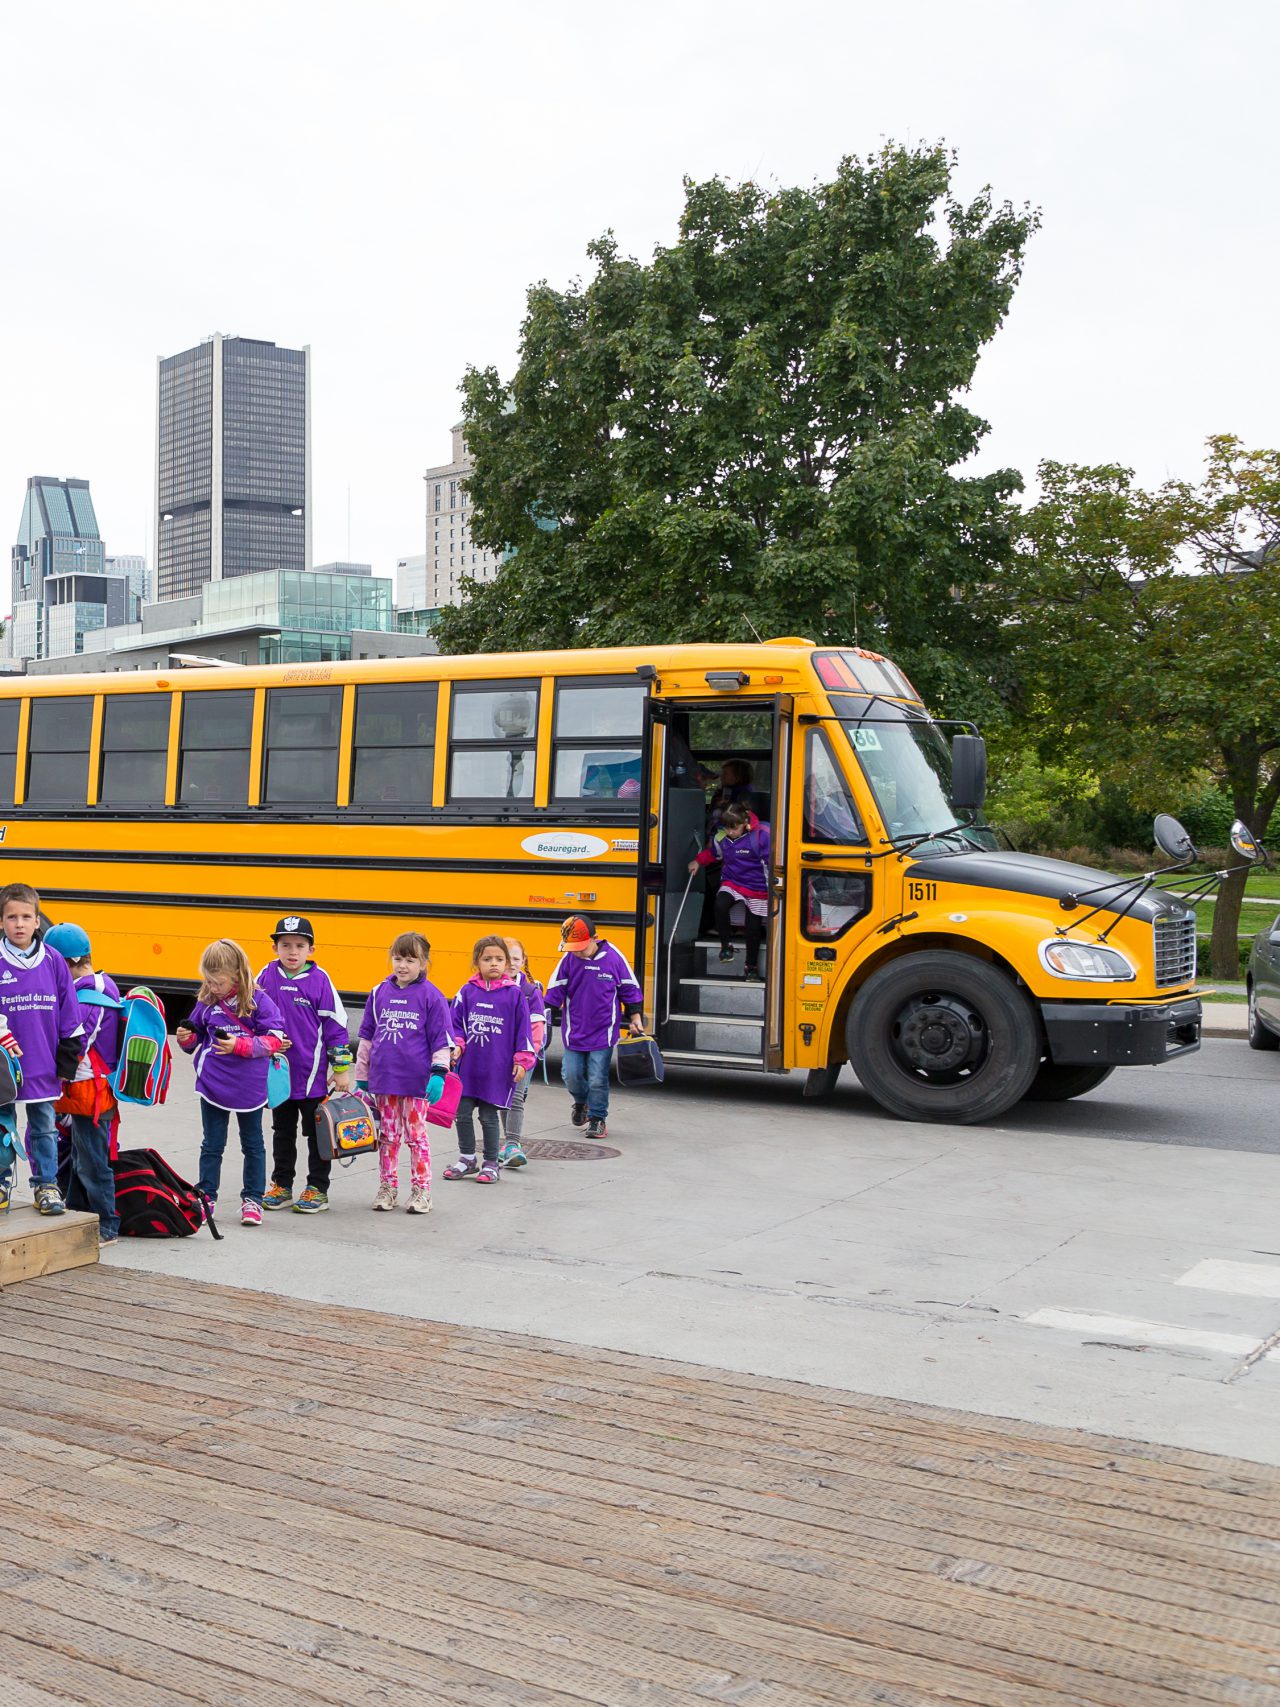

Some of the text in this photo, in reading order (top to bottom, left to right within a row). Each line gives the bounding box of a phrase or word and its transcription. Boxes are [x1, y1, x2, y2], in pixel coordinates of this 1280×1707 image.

[537, 844, 587, 854] Beauregard
[908, 883, 937, 901] 1511
[1, 993, 32, 1005] Festival
[33, 993, 42, 1001] du
[381, 1008, 420, 1020] Dépanneur
[386, 1018, 405, 1032] Chez
